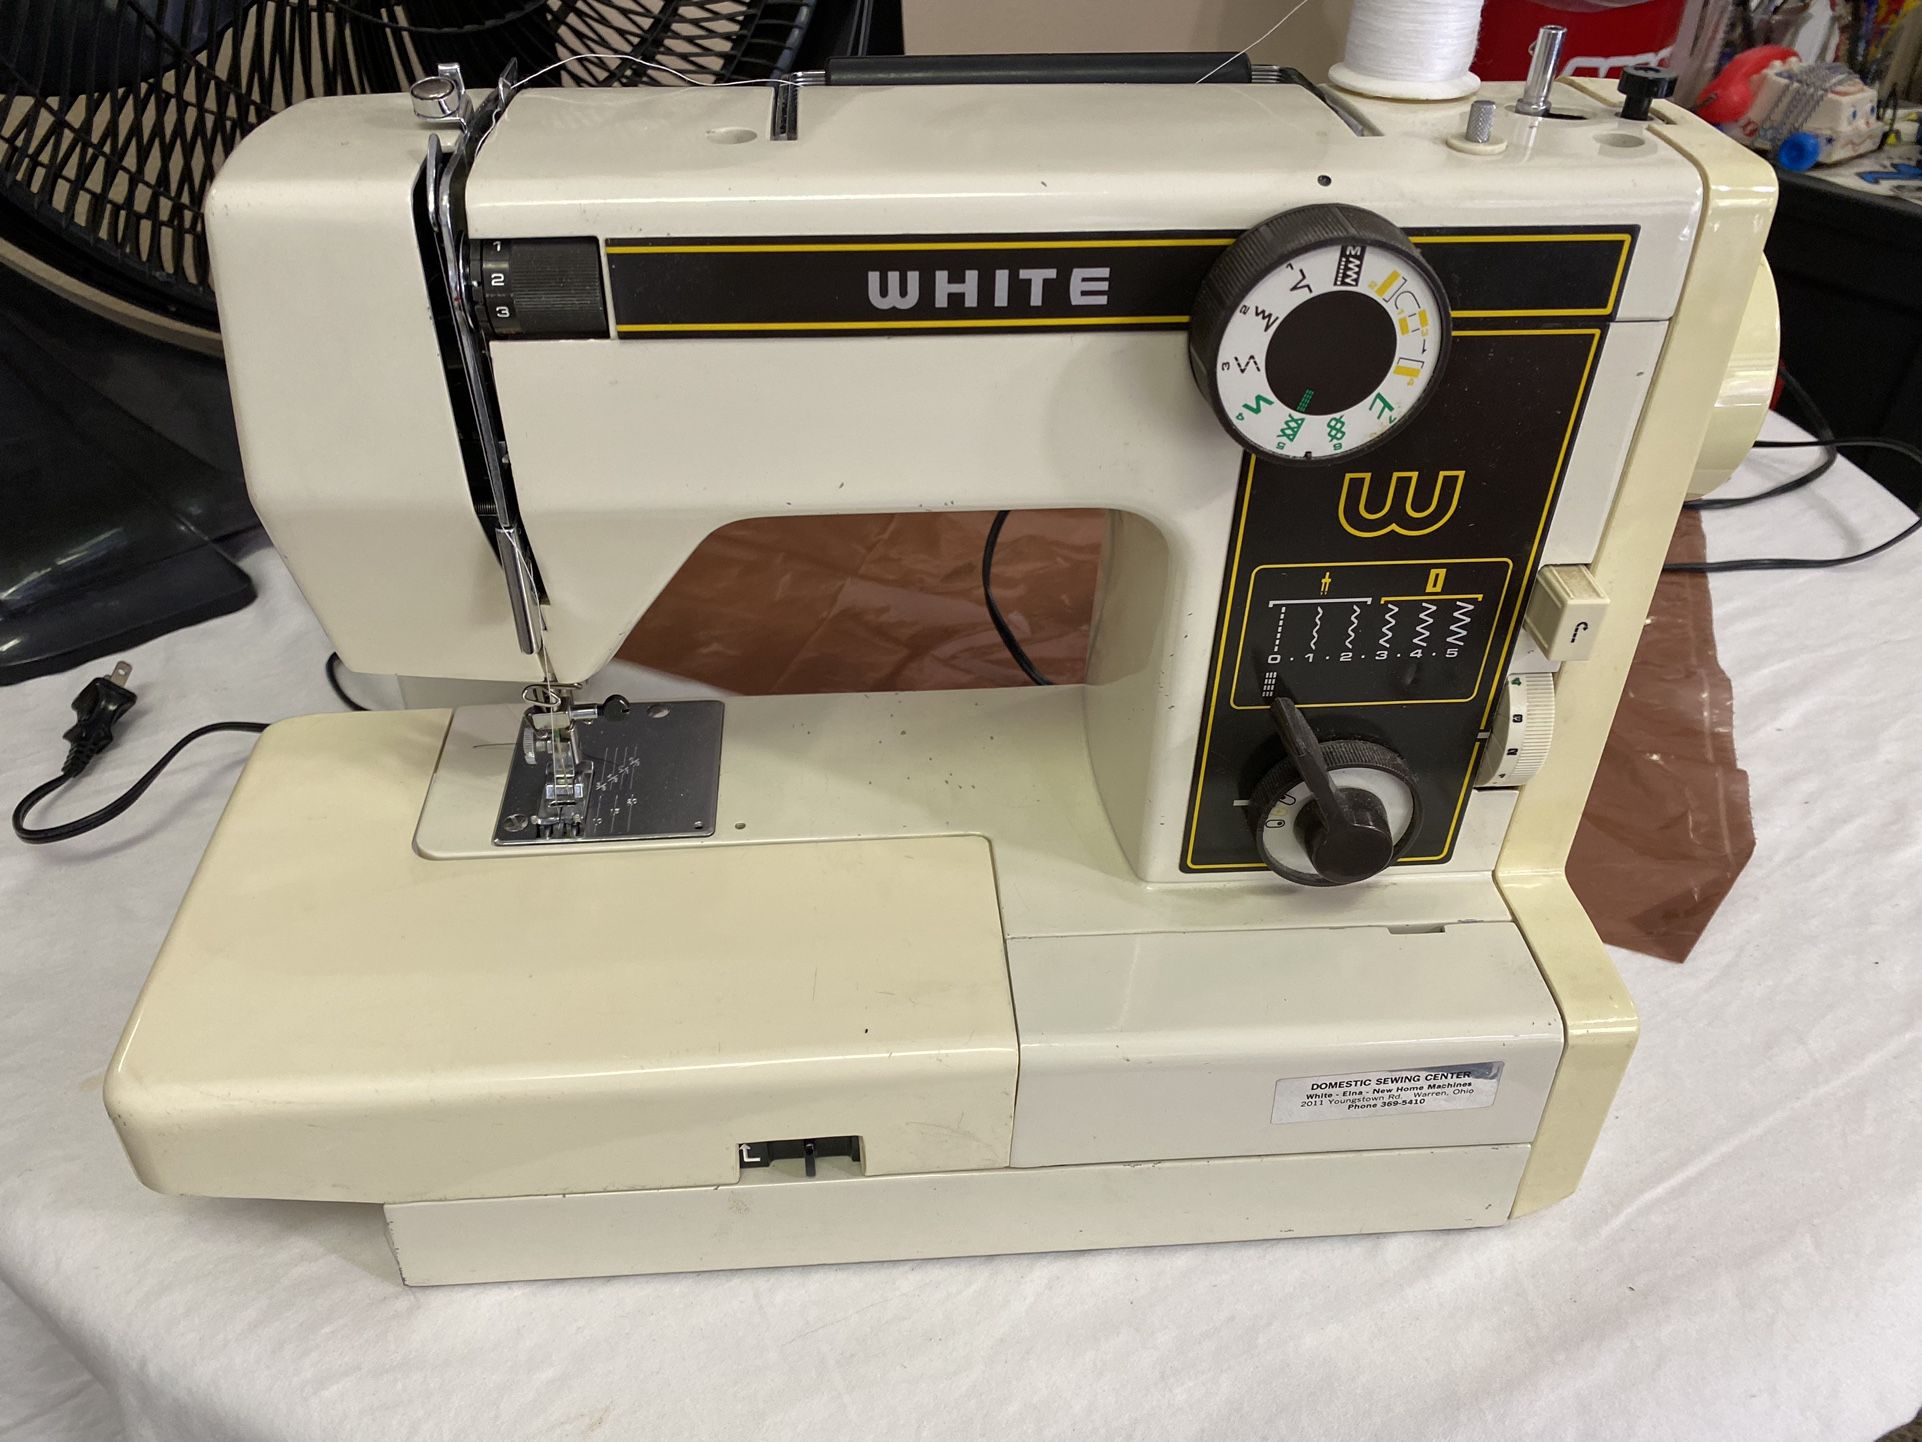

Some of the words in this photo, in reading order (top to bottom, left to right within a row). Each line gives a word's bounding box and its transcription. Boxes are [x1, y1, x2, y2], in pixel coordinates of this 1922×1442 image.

[493, 241, 501, 252] 1
[491, 273, 505, 286] 2
[868, 267, 1111, 310] WHITE
[496, 306, 510, 318] 3
[1239, 304, 1250, 316] 2
[1221, 361, 1230, 371] 3
[1267, 654, 1281, 664] 0
[1304, 653, 1315, 662] 1
[1339, 652, 1353, 662] 2
[1375, 650, 1388, 660] 3
[1409, 649, 1423, 659] 4
[1445, 648, 1459, 658] 5
[1311, 1079, 1372, 1091] DOMESTIC
[1375, 1075, 1421, 1086] SEWING
[1425, 1071, 1472, 1082] CENTER
[1306, 1092, 1333, 1100] White
[1427, 1081, 1472, 1090] Machines
[1300, 1100, 1323, 1108] 2011
[1328, 1095, 1385, 1105] Youngstown
[1380, 1098, 1425, 1107] 369-5410
